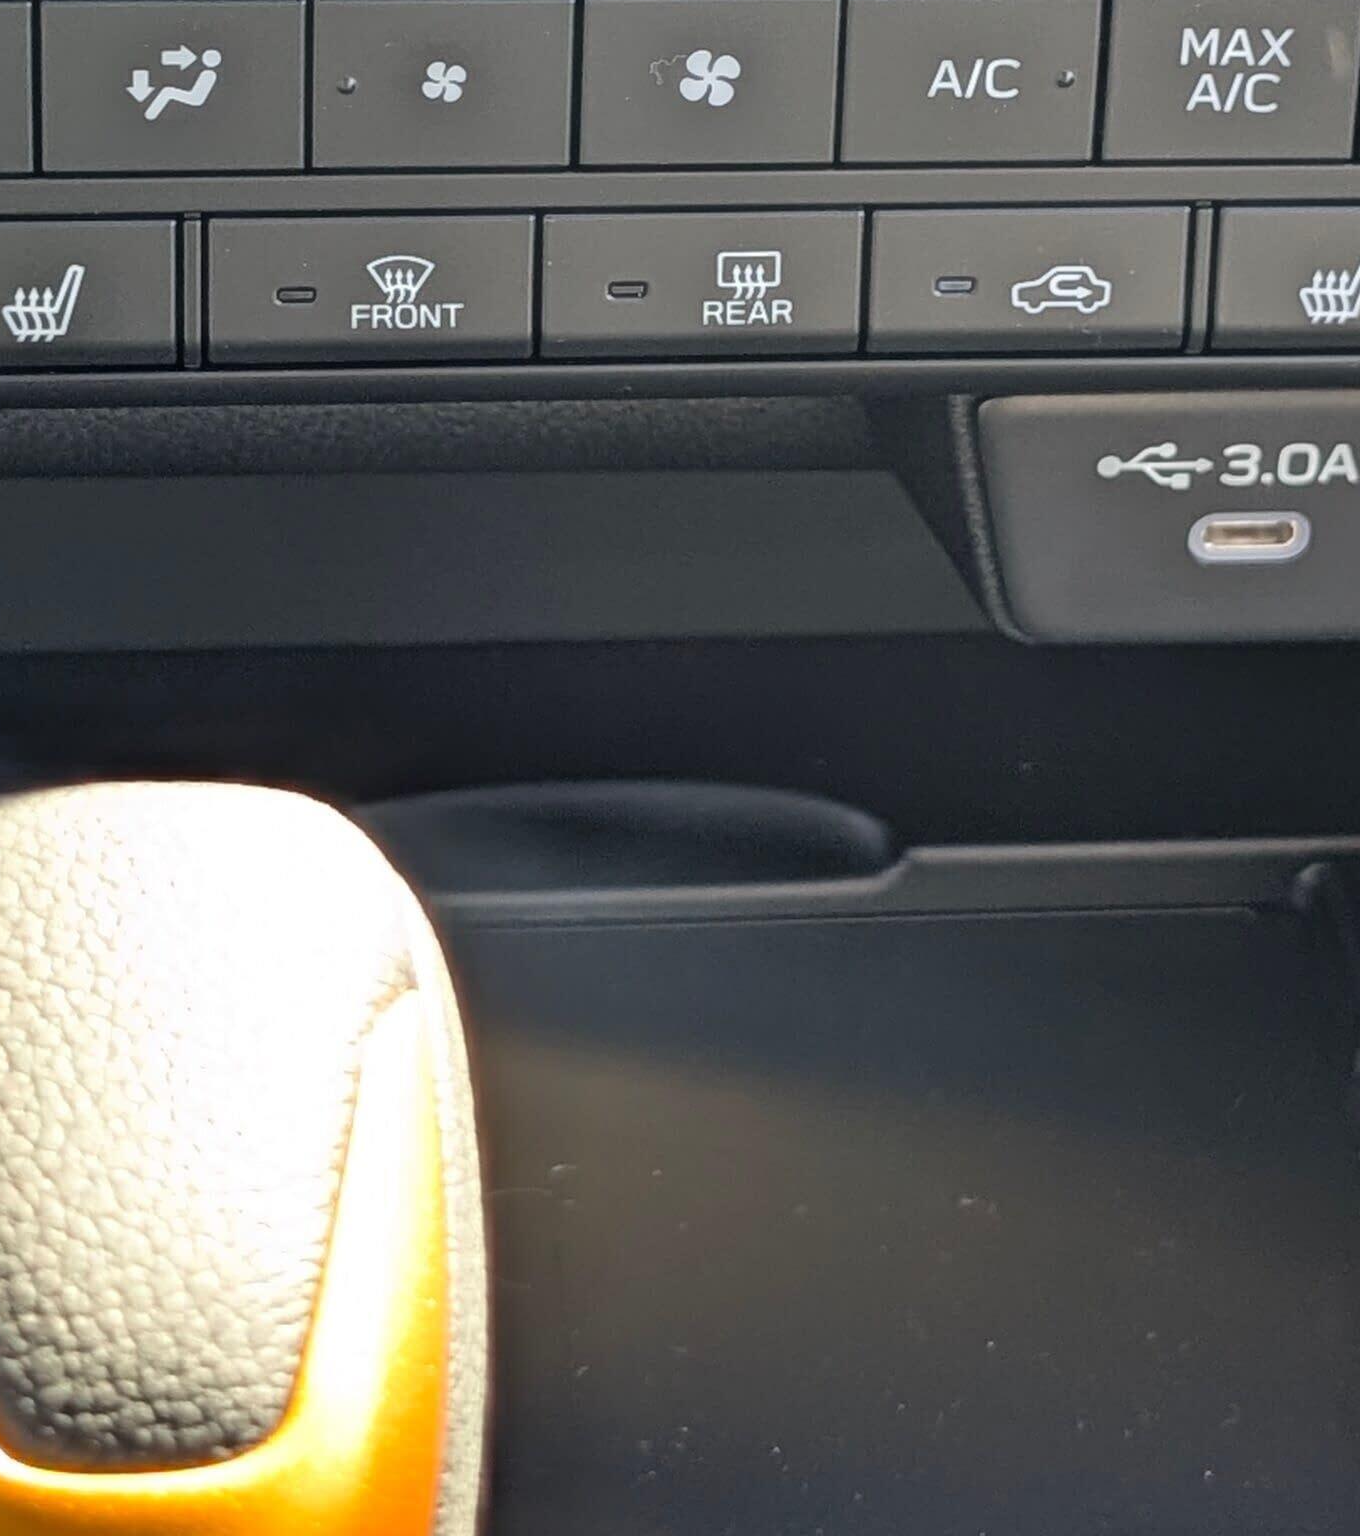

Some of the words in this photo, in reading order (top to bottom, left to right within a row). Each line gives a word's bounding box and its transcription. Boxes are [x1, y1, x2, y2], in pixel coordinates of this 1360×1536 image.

[1179, 27, 1295, 67] MAX
[927, 56, 1022, 102] A/C
[1185, 71, 1281, 116] A/C
[349, 302, 465, 331] FRONT
[701, 299, 793, 327] REAR
[1218, 442, 1360, 486] 3.0A
